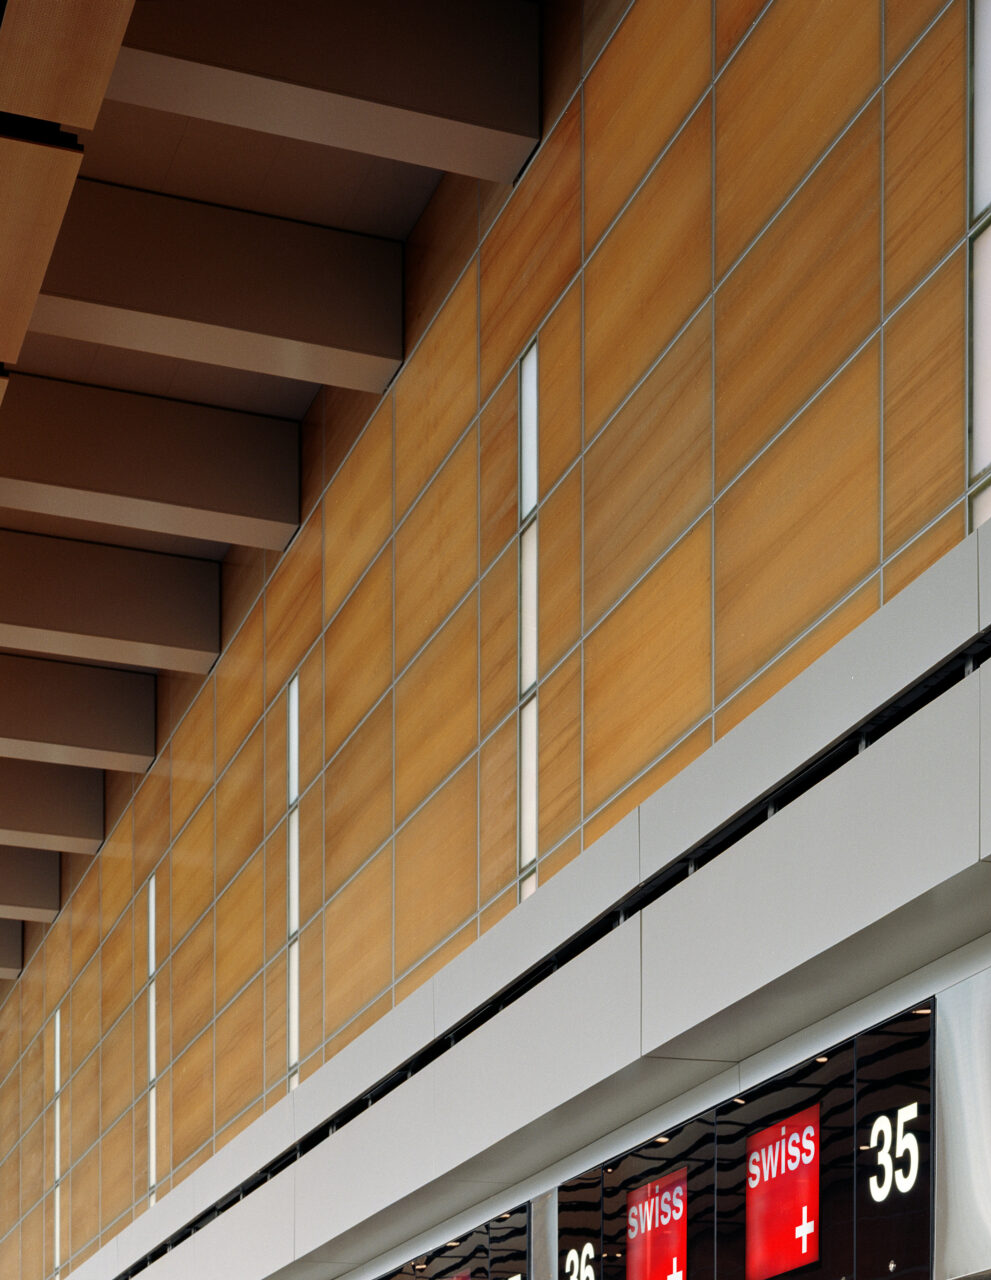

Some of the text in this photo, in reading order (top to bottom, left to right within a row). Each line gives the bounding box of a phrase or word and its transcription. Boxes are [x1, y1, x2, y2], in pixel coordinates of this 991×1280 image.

[748, 1125, 816, 1189] swiss
[869, 1101, 919, 1203] 35
[628, 1184, 684, 1239] swiss
